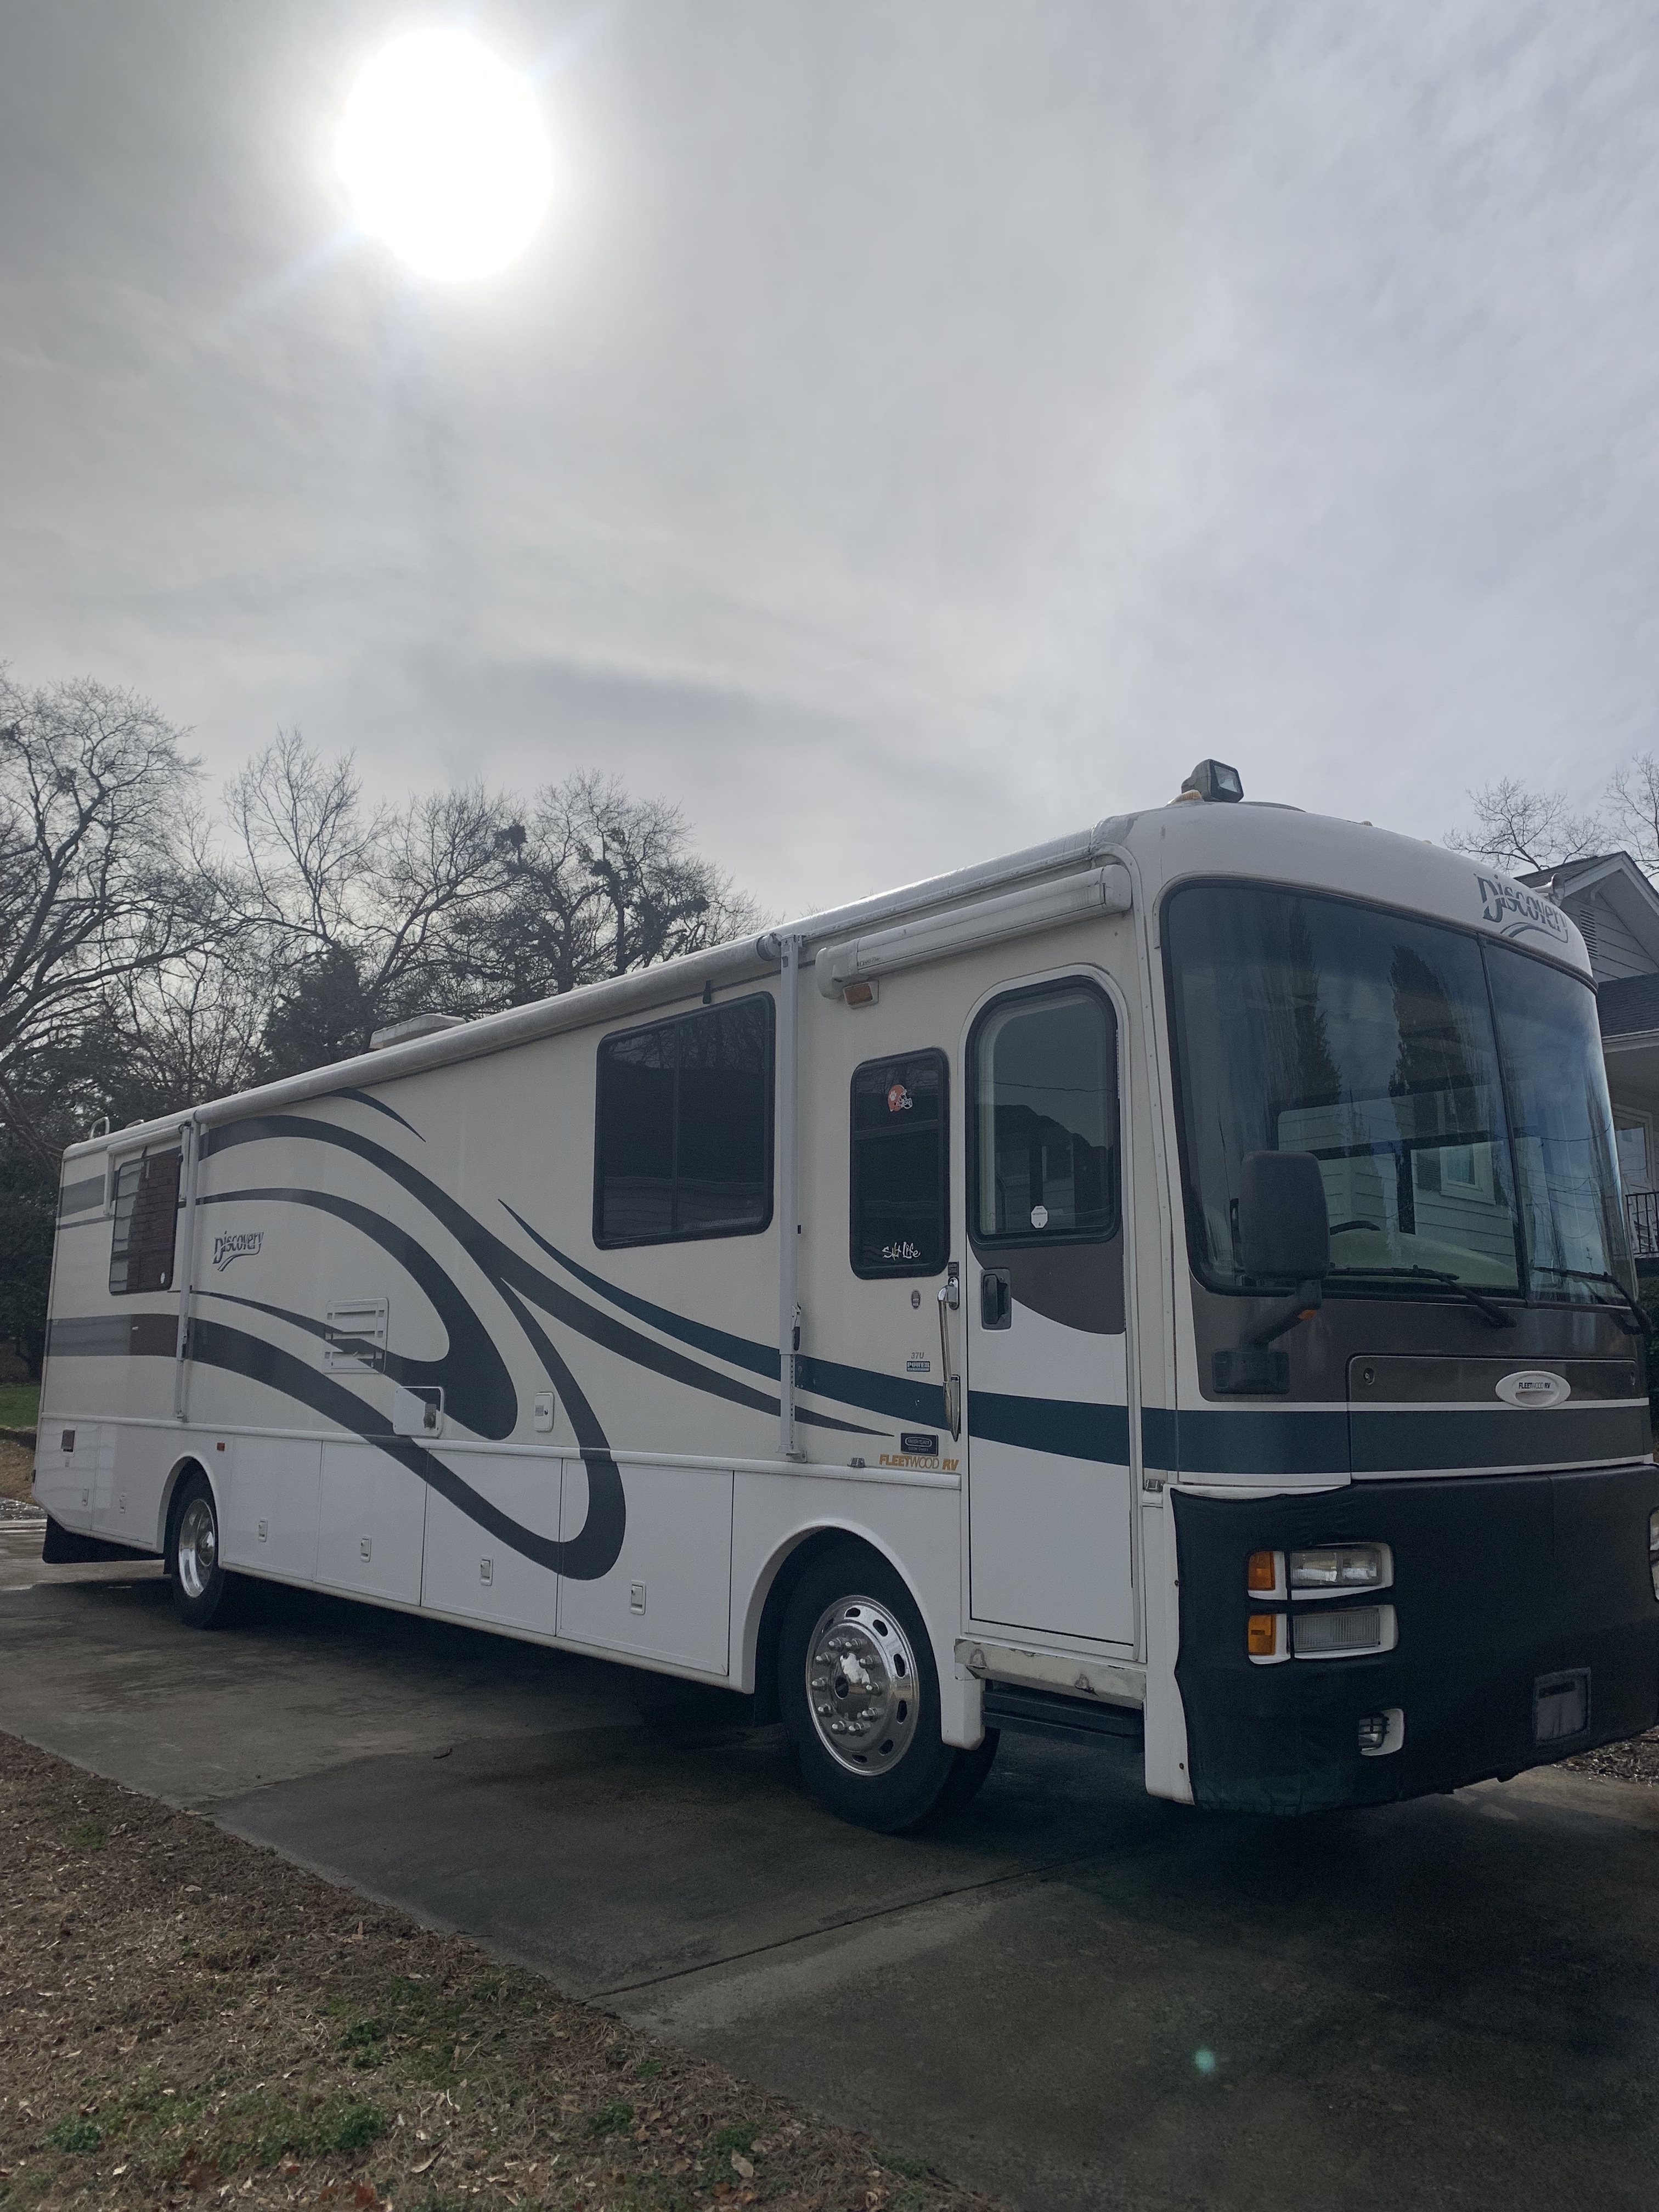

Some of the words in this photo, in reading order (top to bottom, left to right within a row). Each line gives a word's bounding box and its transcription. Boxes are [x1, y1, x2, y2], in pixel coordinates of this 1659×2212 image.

[902, 1242, 921, 1259] Life
[879, 1454, 939, 1469] FLEETWOOD
[942, 1458, 959, 1471] RV
